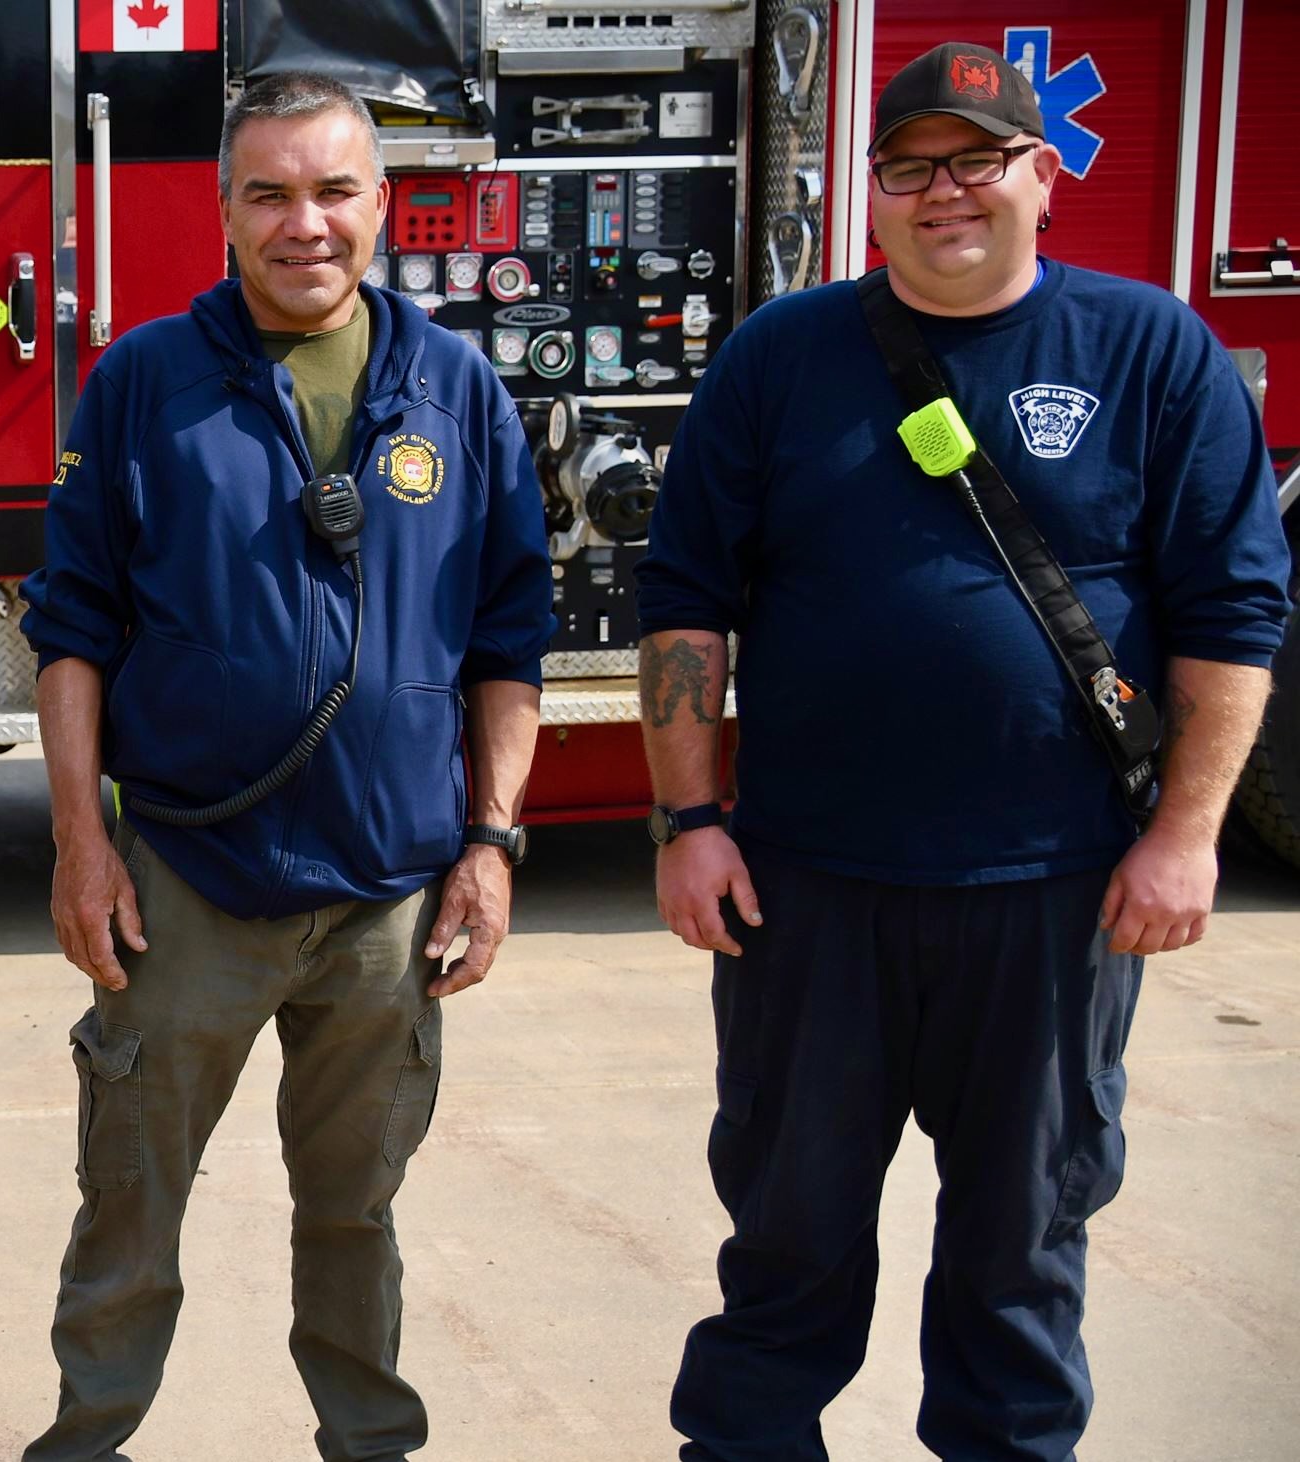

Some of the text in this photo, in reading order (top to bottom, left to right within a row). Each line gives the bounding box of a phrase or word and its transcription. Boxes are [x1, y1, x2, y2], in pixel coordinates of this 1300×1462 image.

[1020, 389, 1087, 407] HIGH LEVEL
[1044, 405, 1062, 413] FIRE
[388, 434, 438, 454] HAY RIVER
[1034, 446, 1065, 455] ALBERTA
[377, 455, 386, 475] FIRE
[432, 457, 445, 494] RESCUE
[385, 485, 434, 505] AMBULANCE
